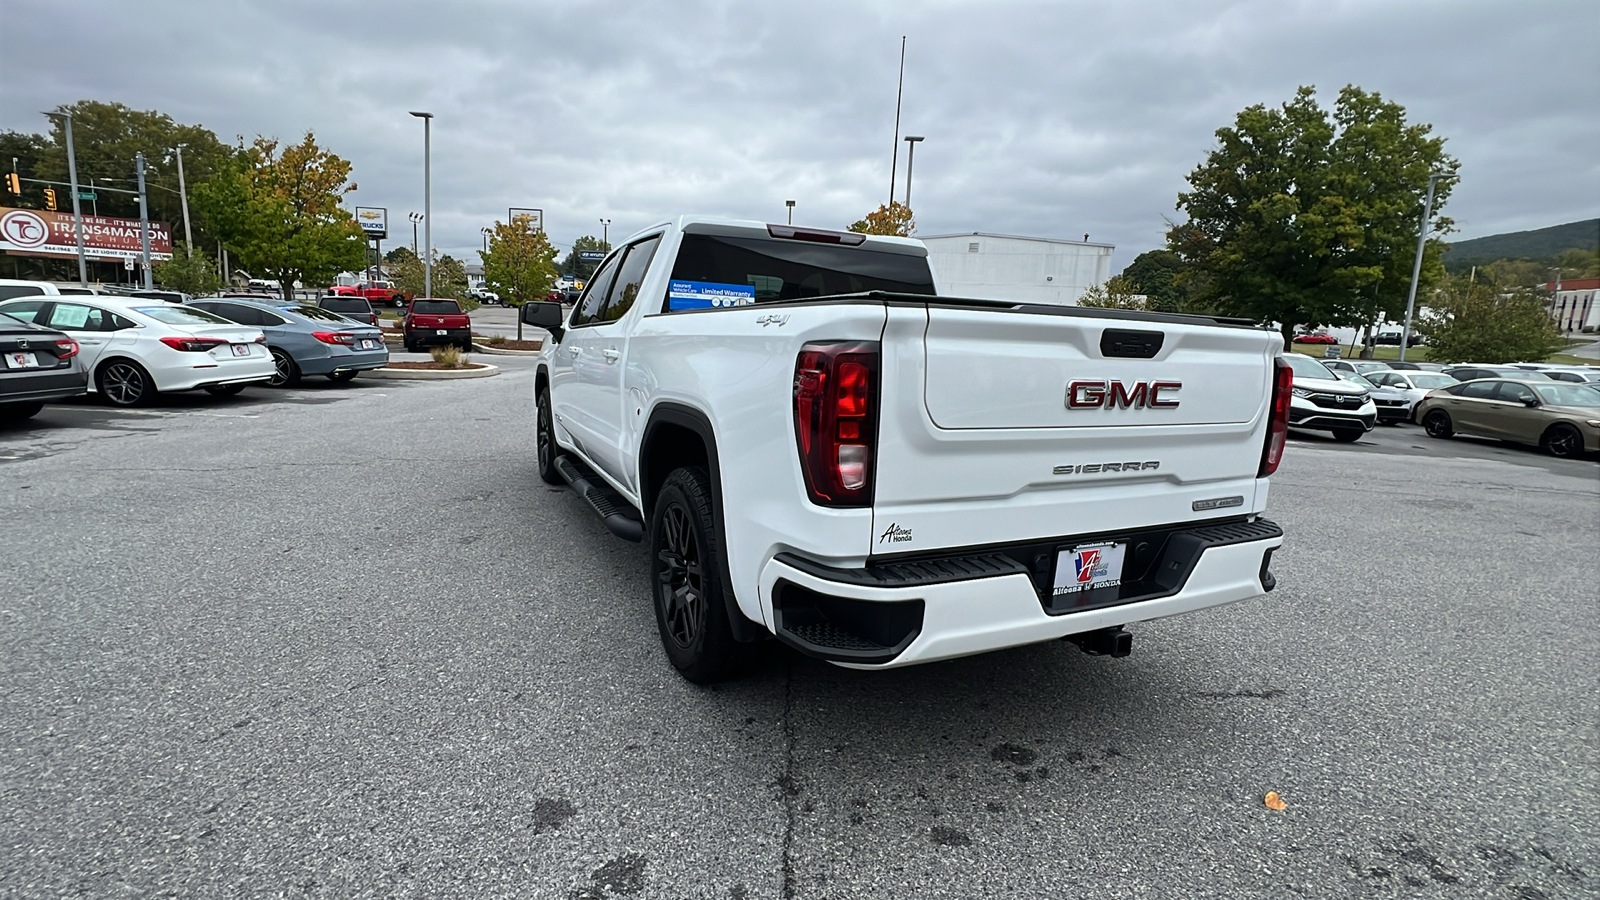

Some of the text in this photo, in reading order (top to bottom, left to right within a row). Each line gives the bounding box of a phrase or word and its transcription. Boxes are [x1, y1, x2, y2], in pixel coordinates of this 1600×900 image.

[50, 221, 168, 240] TRANS4MATON
[125, 220, 141, 228] WHAT
[95, 234, 169, 247] CHURCH
[701, 287, 752, 298] Limited Warranty
[1064, 378, 1182, 410] GMC
[1053, 460, 1160, 475] SIERRA
[1052, 579, 1121, 596] Altoona HONDA
